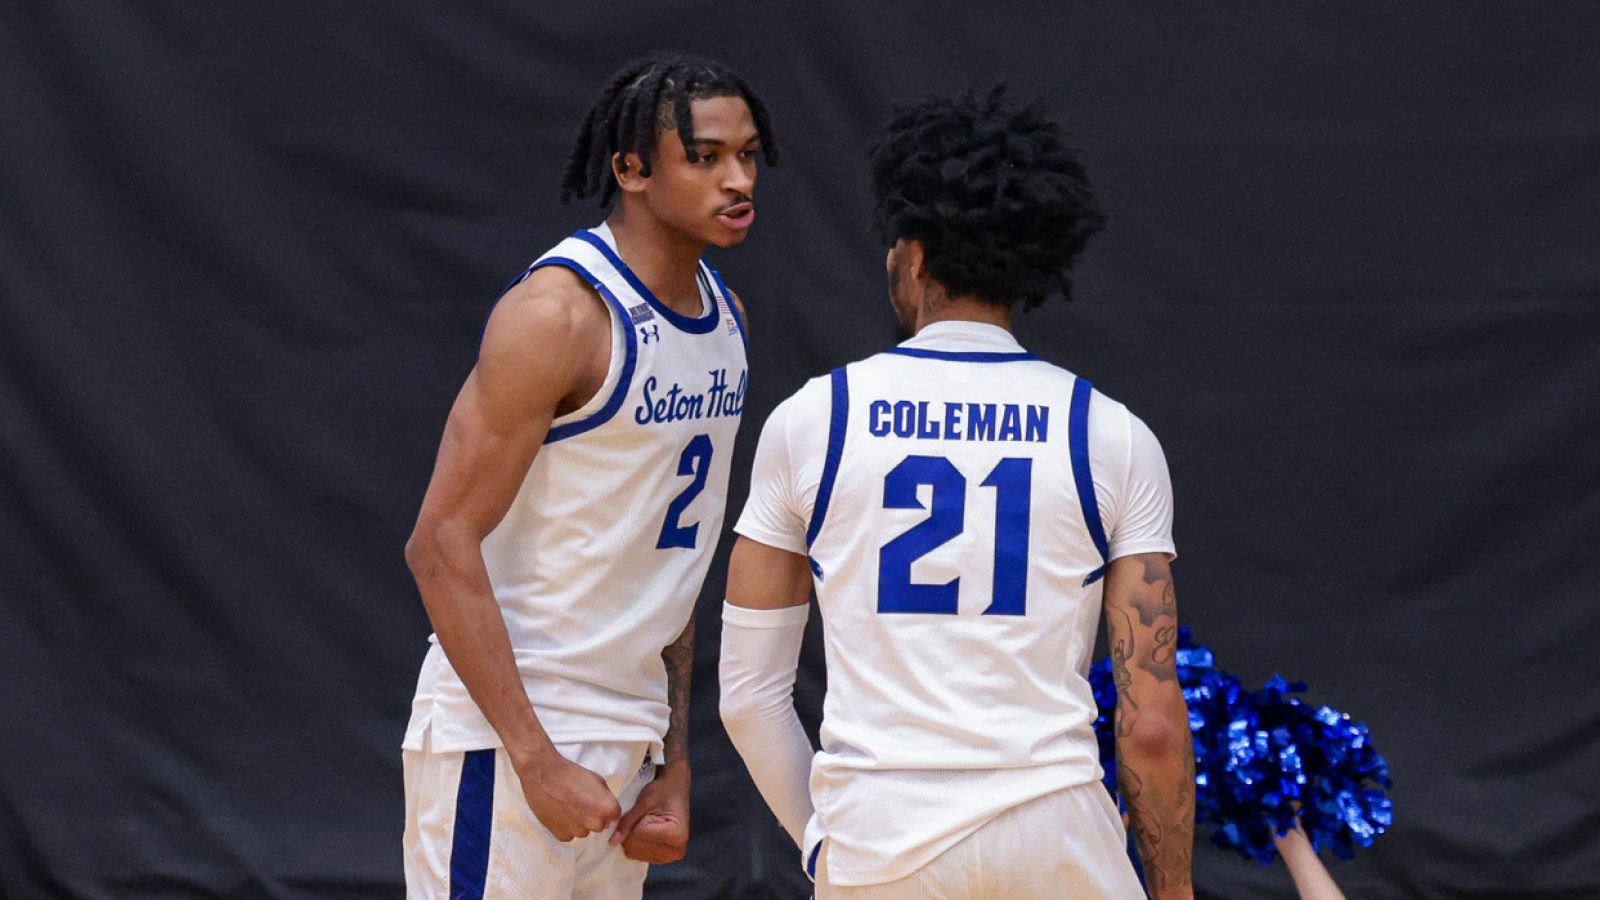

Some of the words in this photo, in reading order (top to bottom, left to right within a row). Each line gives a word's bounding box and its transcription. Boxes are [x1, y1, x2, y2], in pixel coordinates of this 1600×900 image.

[635, 375, 703, 425] Seton
[869, 399, 1050, 443] COLEMAN
[655, 433, 713, 549] 2
[877, 454, 1033, 616] 21
